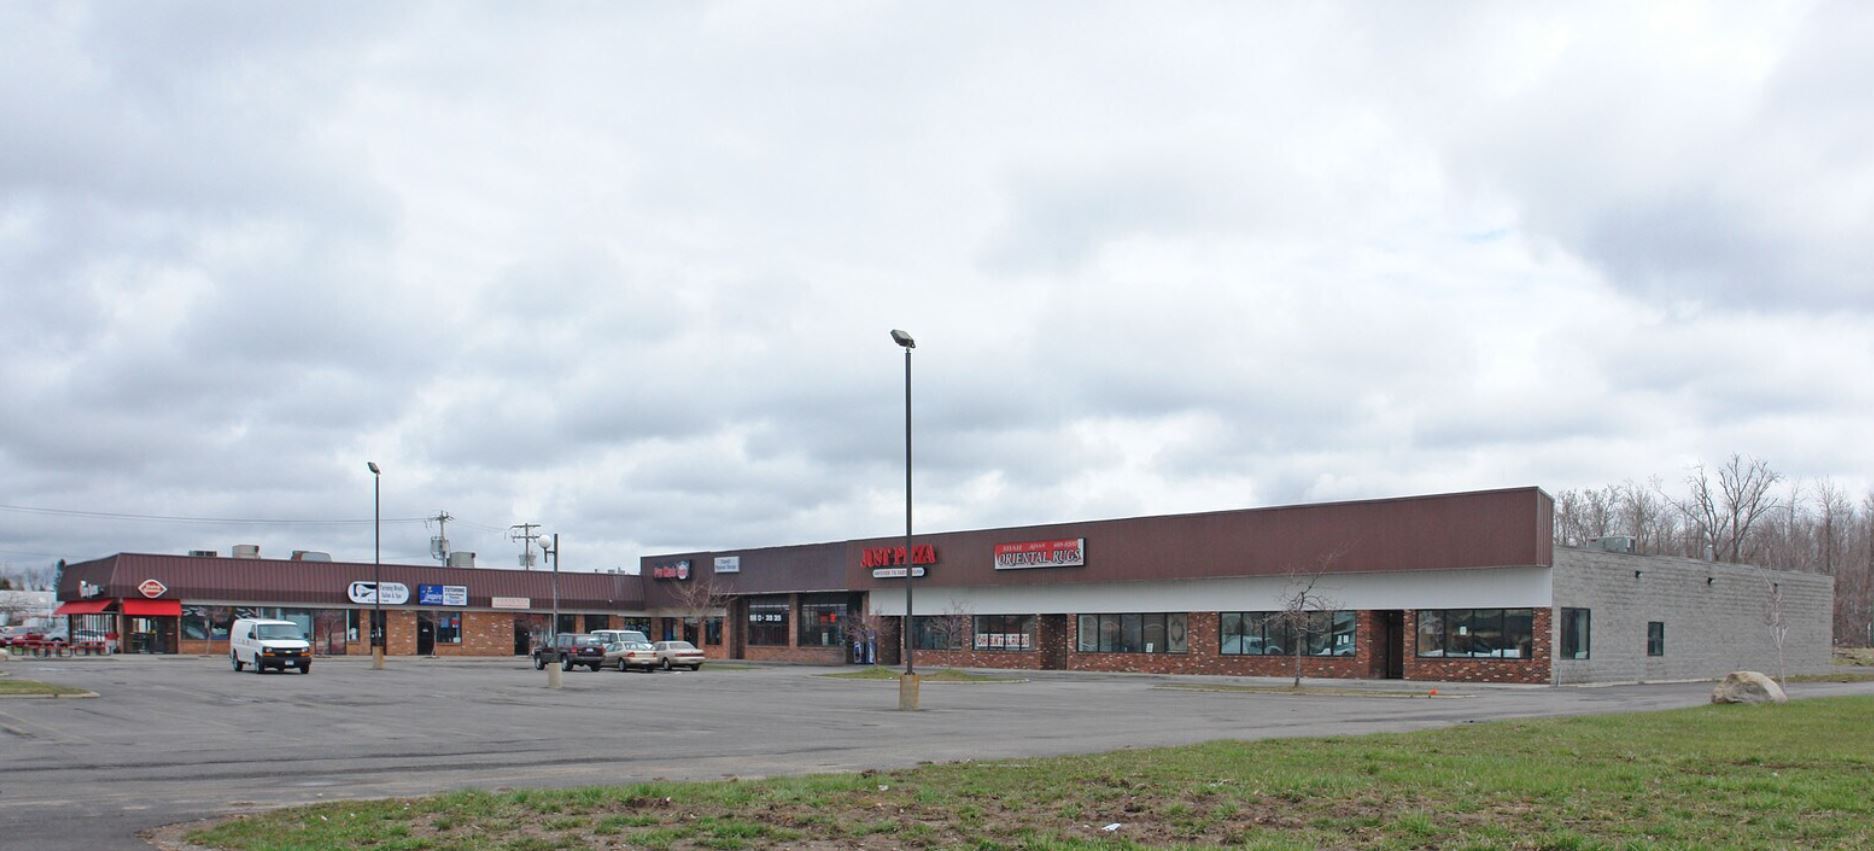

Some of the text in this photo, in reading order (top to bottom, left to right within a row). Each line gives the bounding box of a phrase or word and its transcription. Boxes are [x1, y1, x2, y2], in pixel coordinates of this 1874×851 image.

[861, 547, 890, 568] JUST
[998, 548, 1082, 566] ORIENTAL RUGS
[976, 634, 1011, 646] ORENTL
